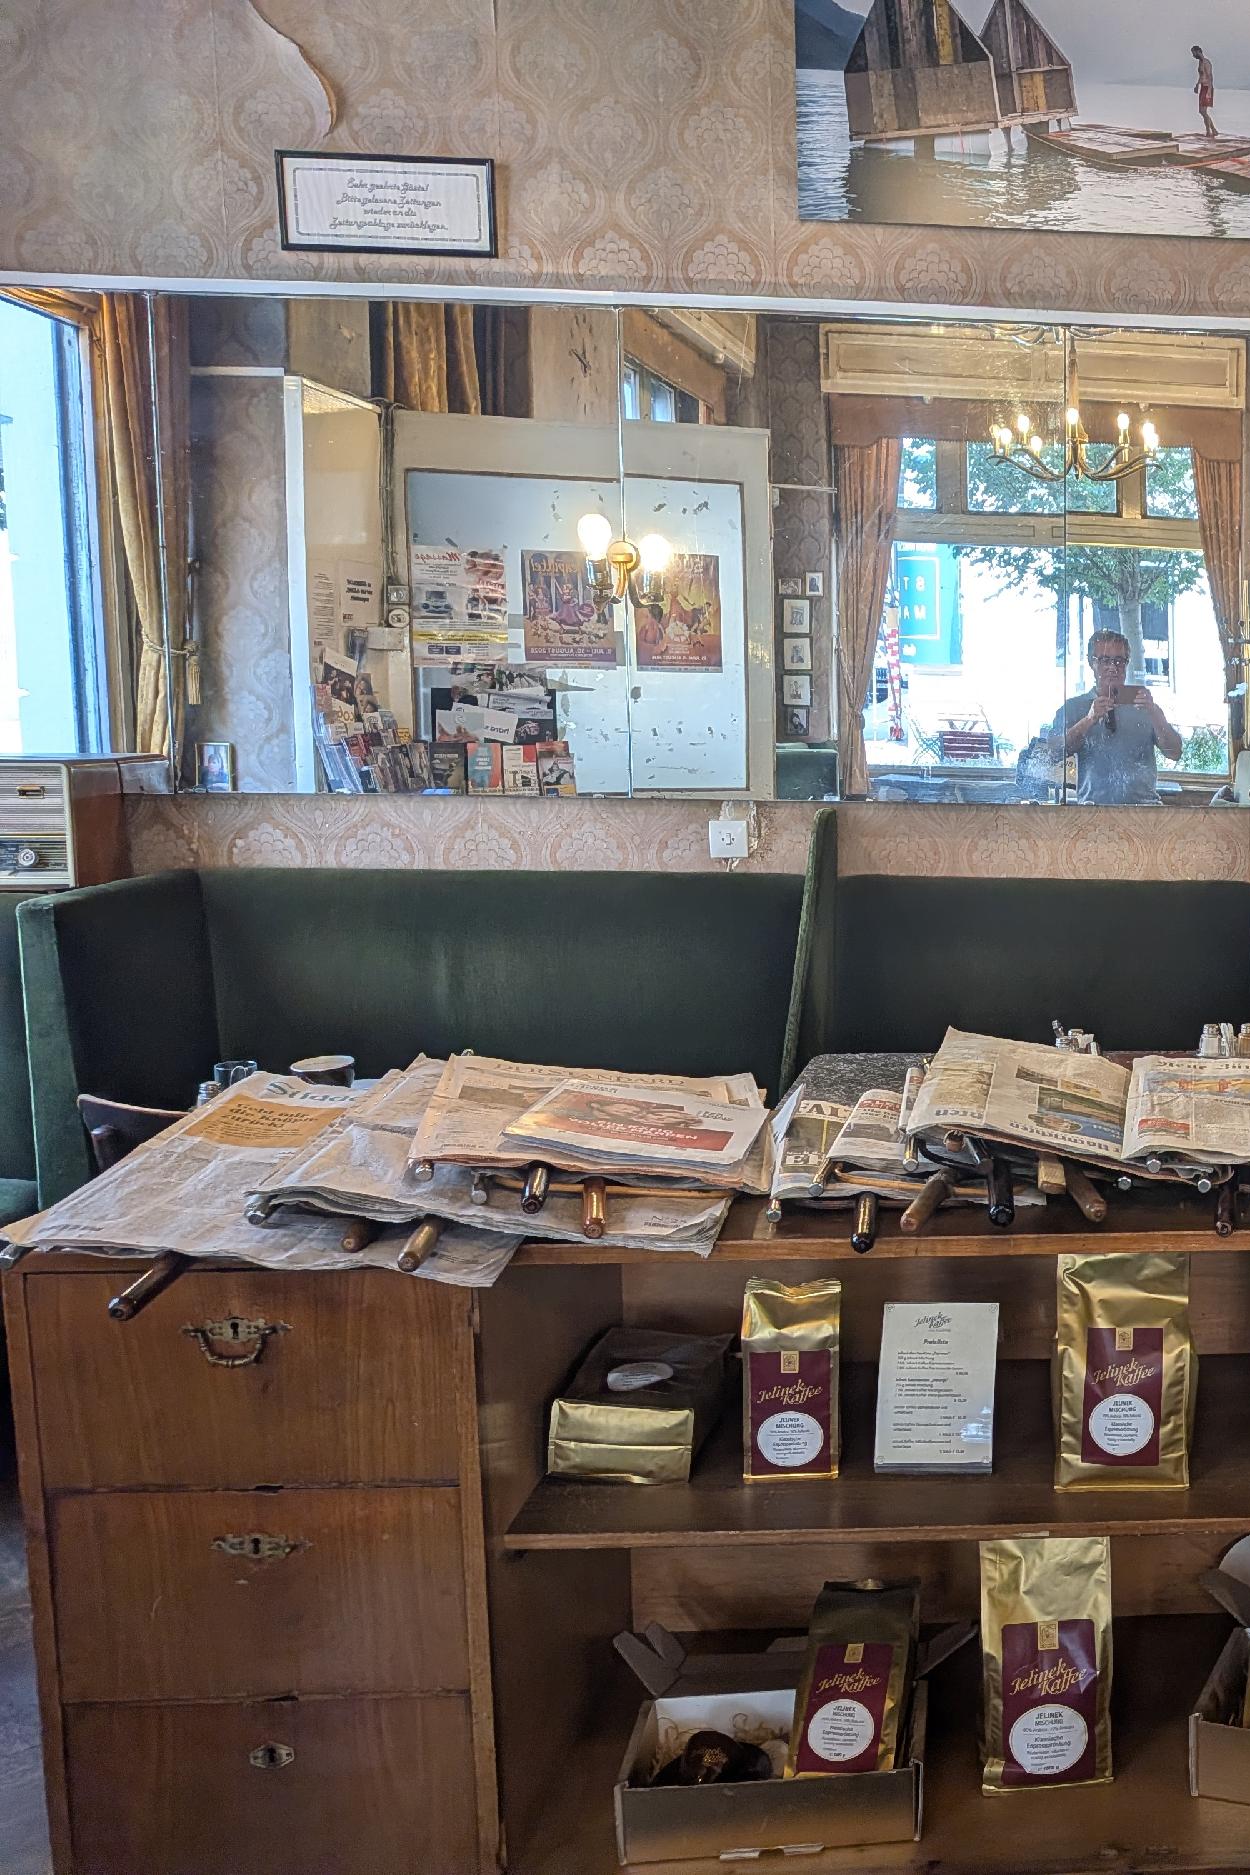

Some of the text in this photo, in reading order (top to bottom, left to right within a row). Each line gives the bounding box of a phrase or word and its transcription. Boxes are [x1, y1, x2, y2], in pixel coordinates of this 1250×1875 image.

[1091, 1357, 1138, 1385] Jelinek
[1114, 1364, 1155, 1387] Kaffee
[757, 1379, 804, 1404] Jelinek
[783, 1386, 823, 1405] Kaffee
[815, 1668, 866, 1694] Jelinek
[838, 1674, 881, 1693] Kaffee
[1009, 1658, 1067, 1696] Jelinek
[1040, 1666, 1088, 1697] Kaffee
[1035, 1711, 1064, 1719] JELINEK
